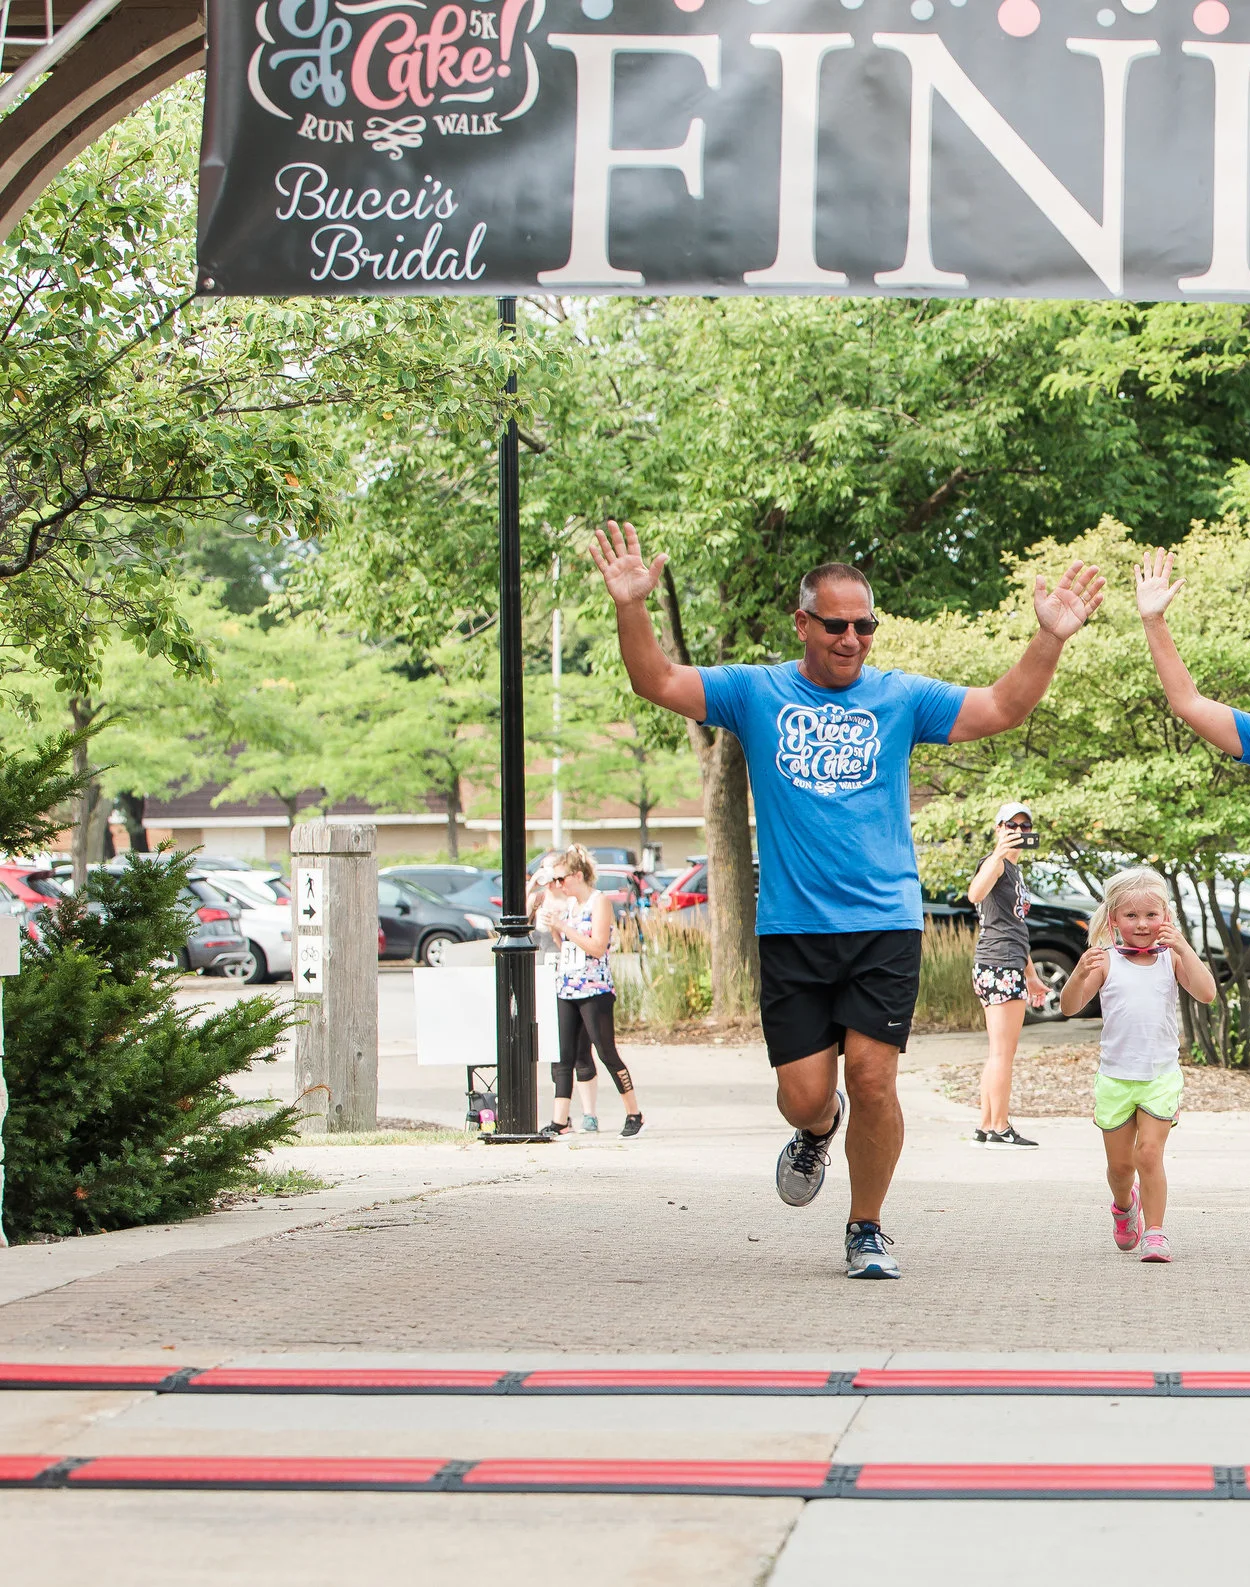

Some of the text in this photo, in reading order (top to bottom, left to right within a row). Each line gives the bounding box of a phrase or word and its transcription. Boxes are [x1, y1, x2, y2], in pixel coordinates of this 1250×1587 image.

[469, 10, 499, 40] 5K
[269, 0, 522, 110] of Cake!
[297, 112, 502, 143] RUN WALK
[275, 162, 458, 221] Bucci's
[310, 222, 487, 281] Bridal
[785, 710, 866, 752] Piece
[782, 741, 874, 780] of Cake!
[853, 747, 865, 758] 5K
[792, 777, 864, 790] RUN WALK
